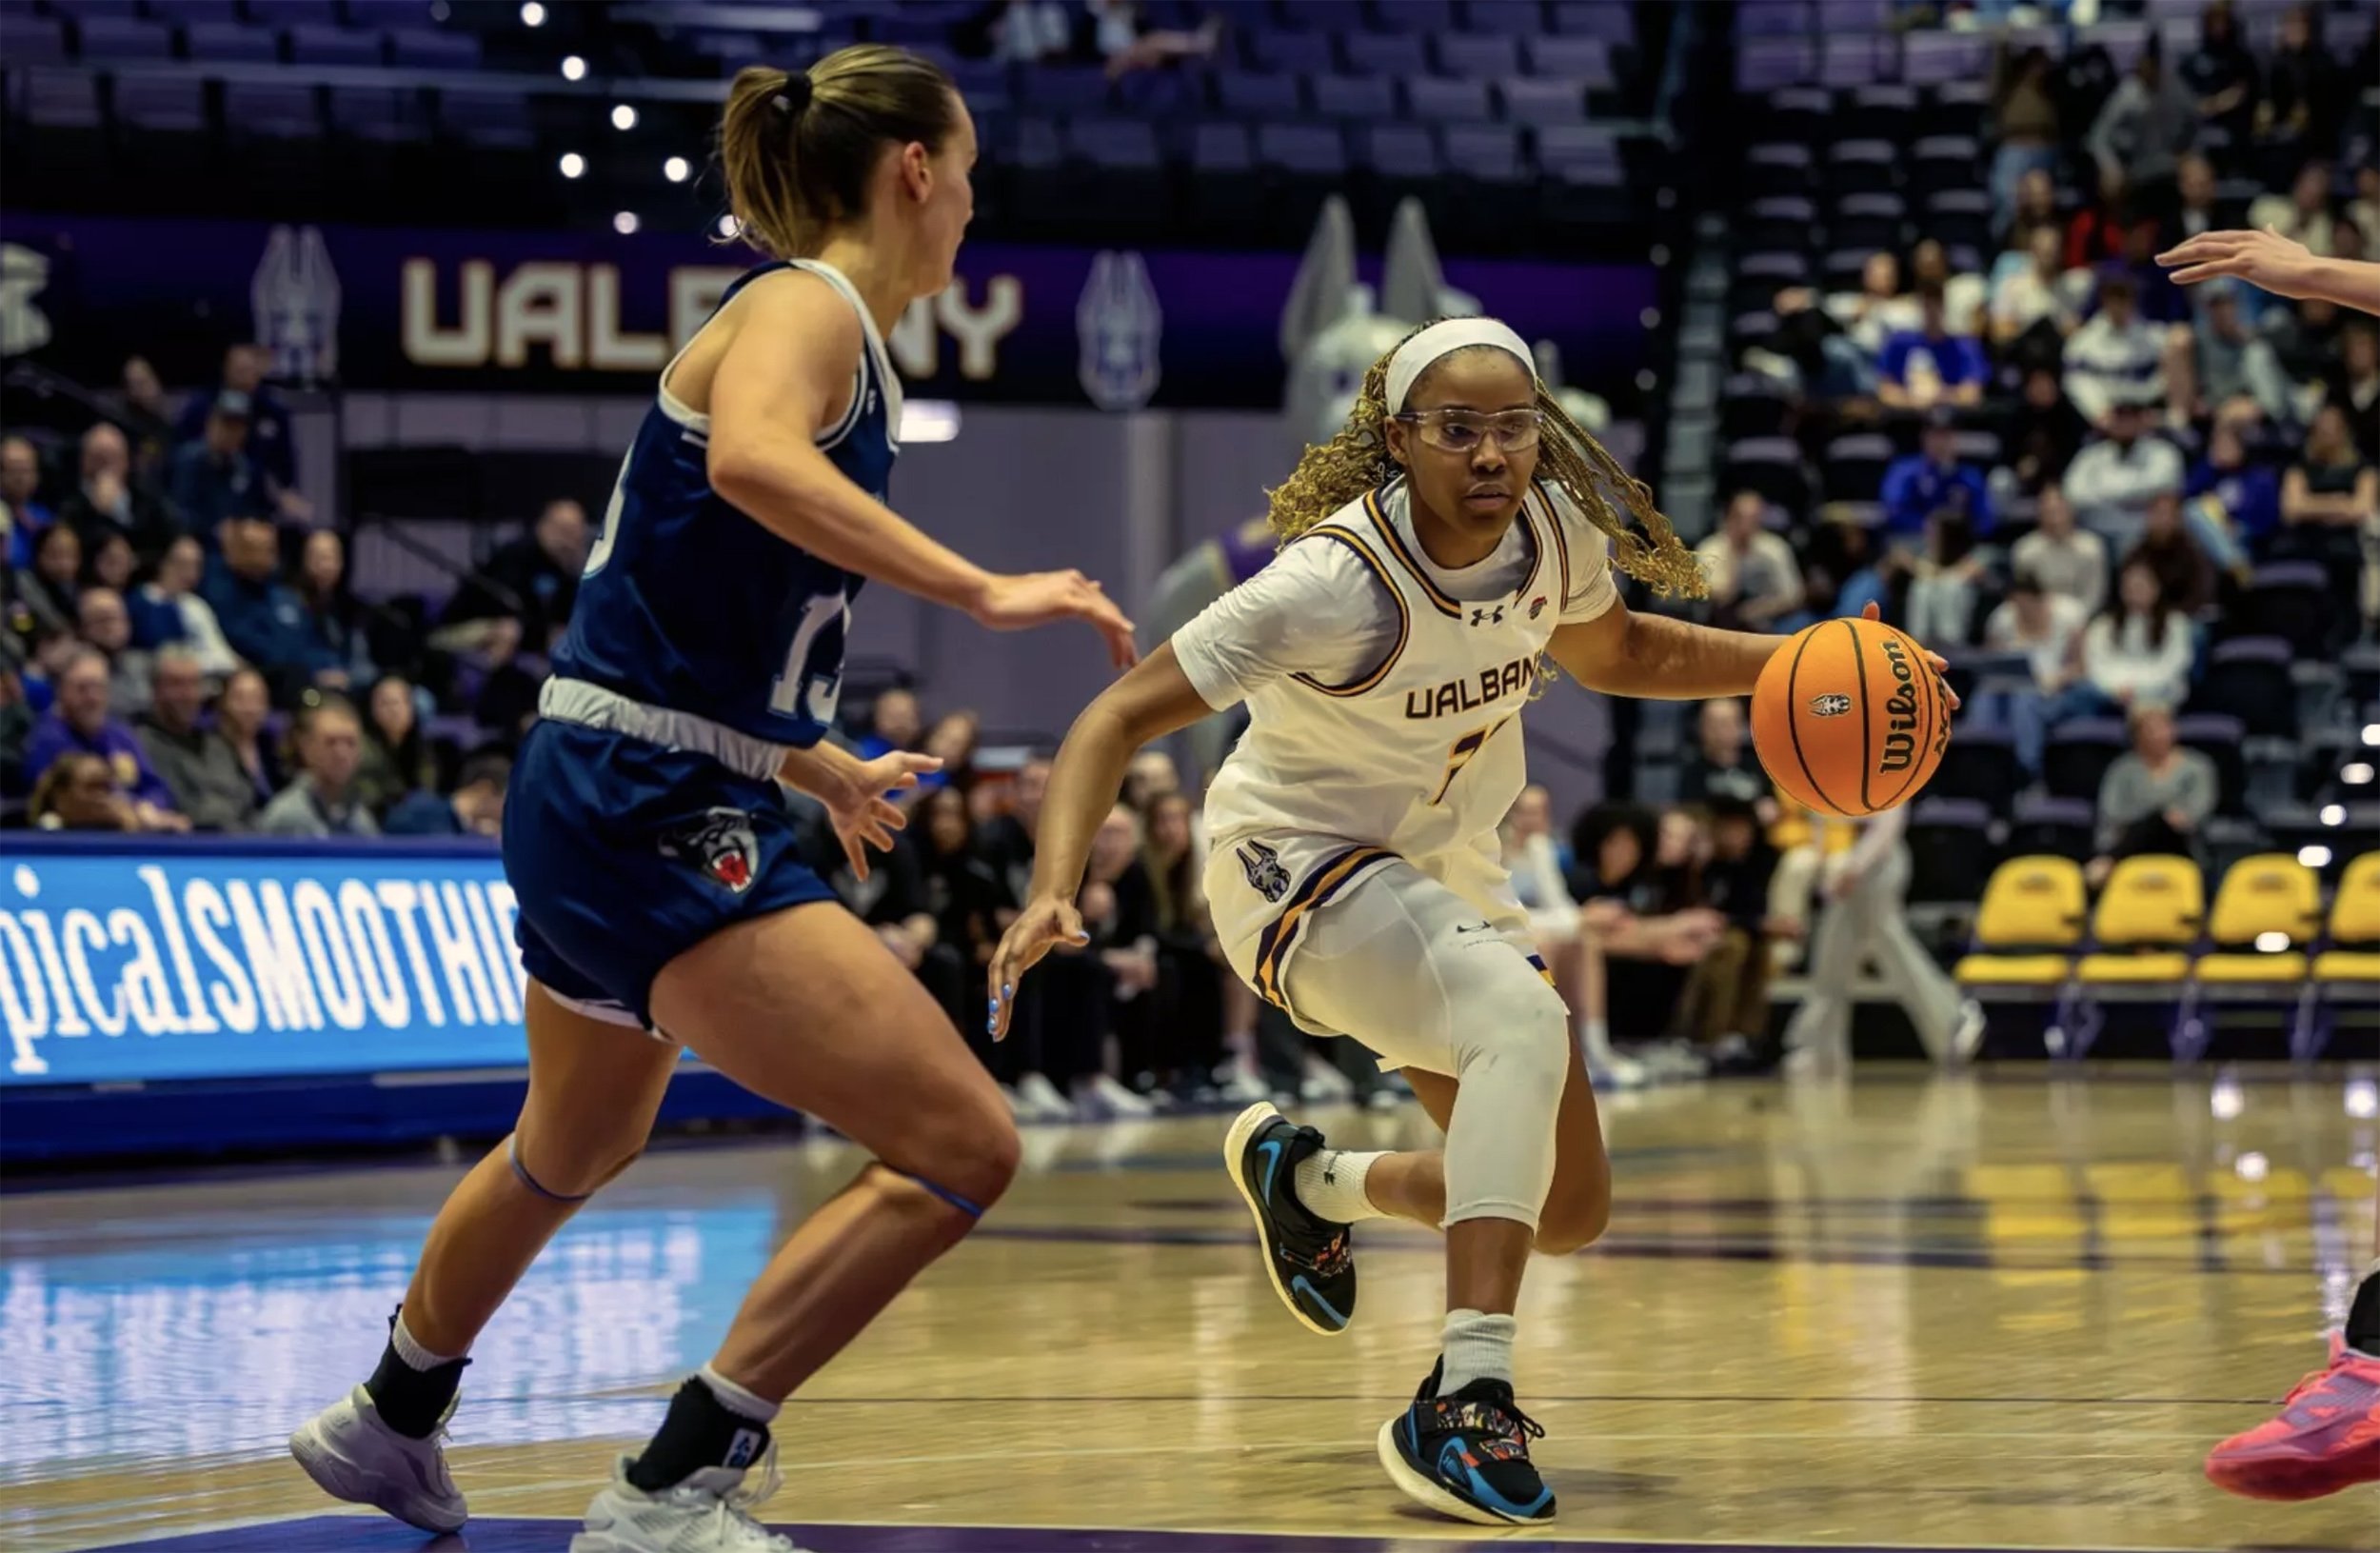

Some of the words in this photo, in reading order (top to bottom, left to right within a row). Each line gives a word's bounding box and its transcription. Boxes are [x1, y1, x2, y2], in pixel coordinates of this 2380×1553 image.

[402, 258, 1022, 380] UALY
[1405, 648, 1542, 720] UALBAN
[1879, 640, 1917, 775] Wilson
